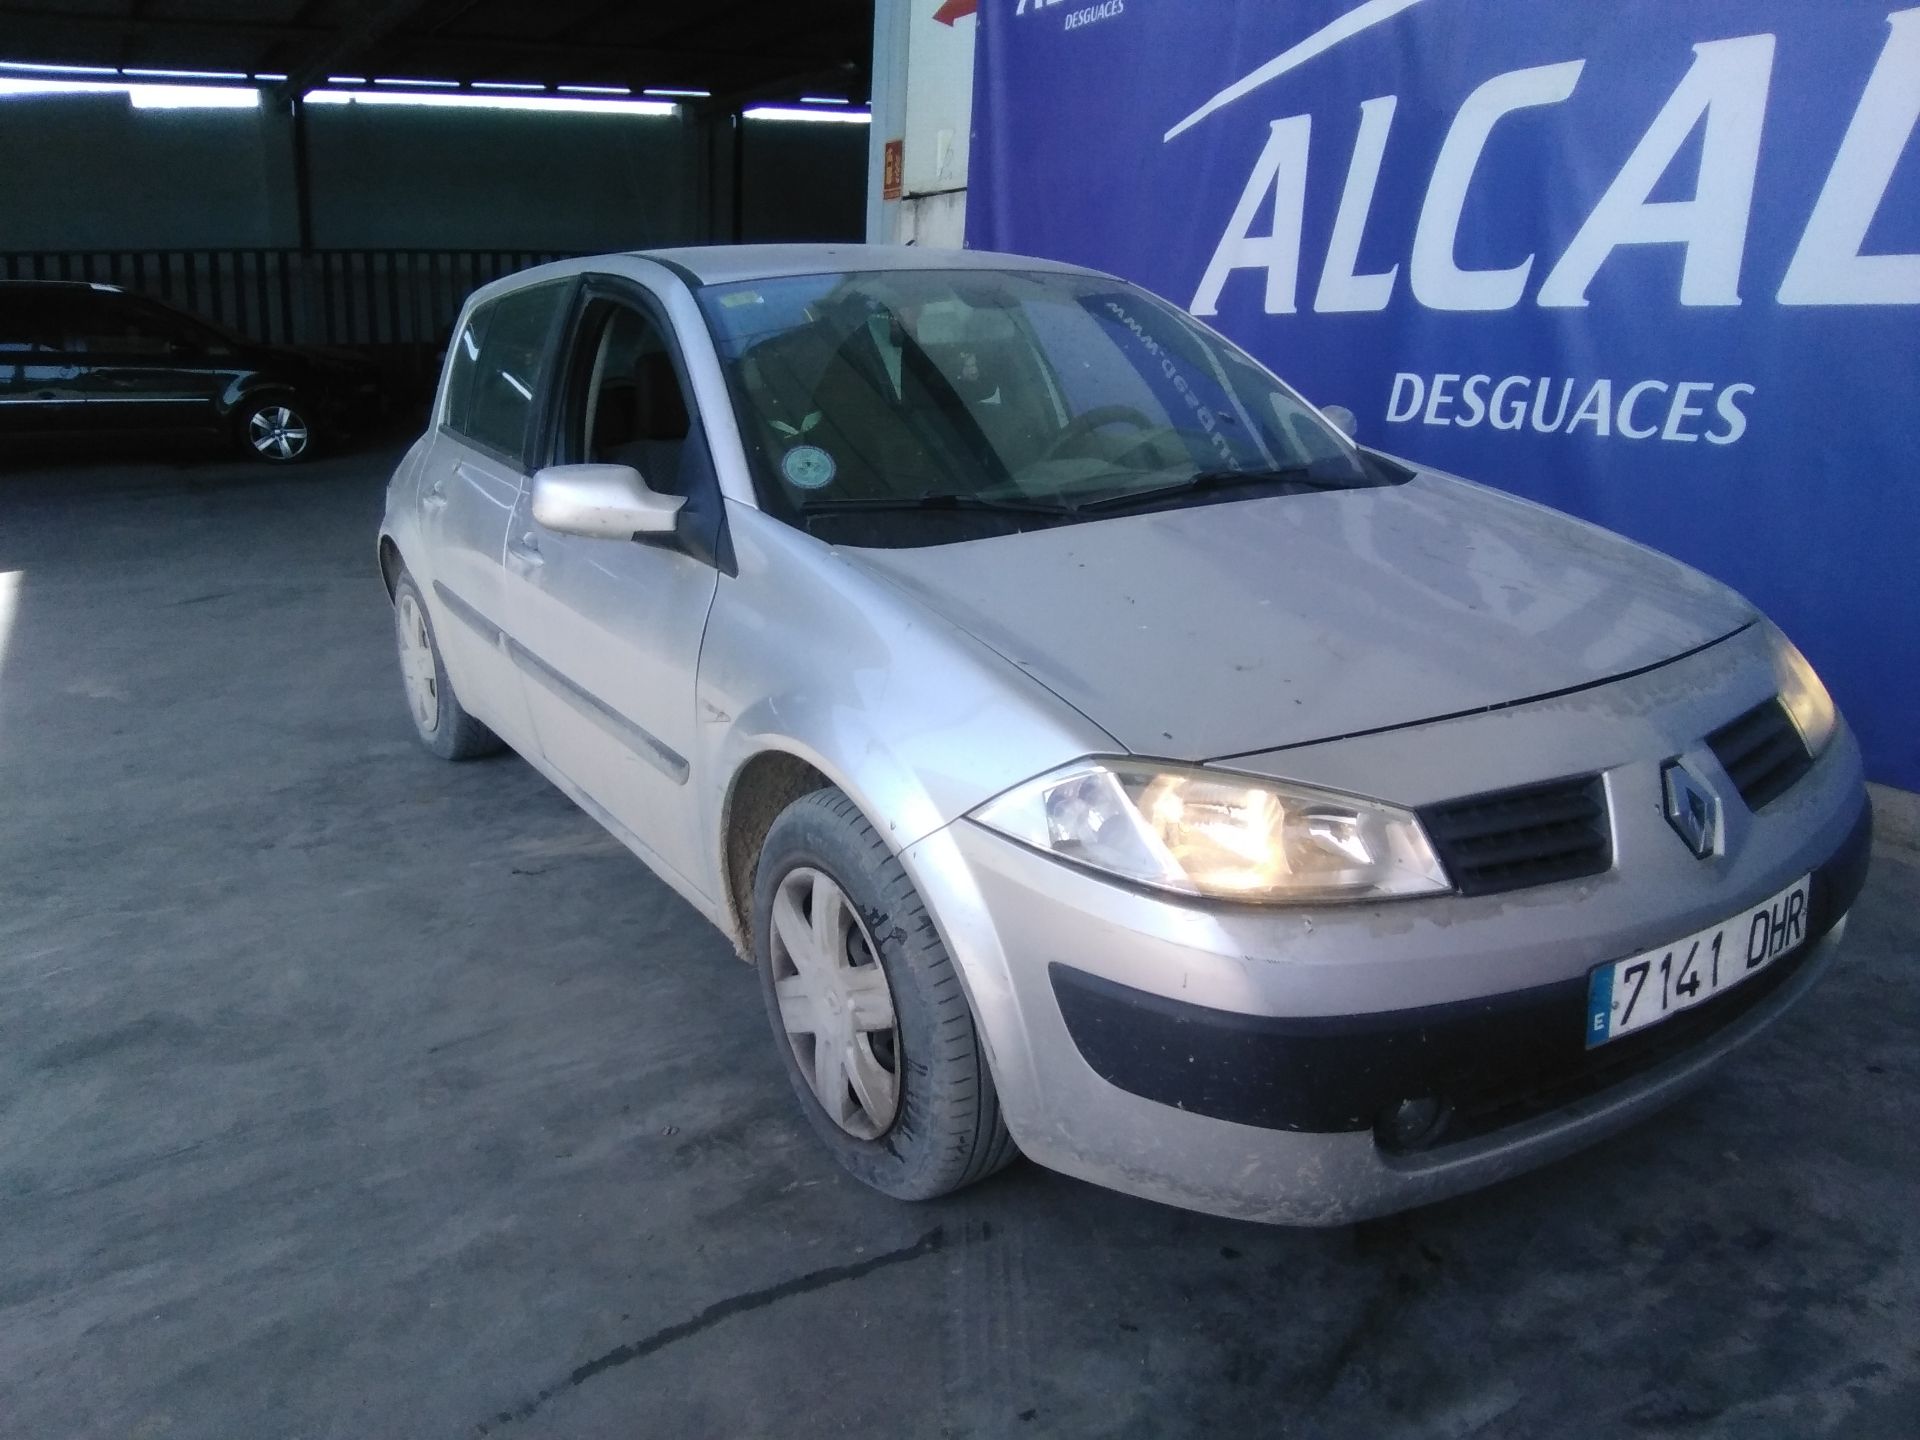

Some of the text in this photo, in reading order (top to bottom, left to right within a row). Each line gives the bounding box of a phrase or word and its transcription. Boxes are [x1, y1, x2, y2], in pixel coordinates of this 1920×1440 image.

[1064, 0, 1125, 30] DESGUACES
[1189, 6, 1920, 315] ALCAL
[1386, 372, 1756, 444] DESGUACES
[1620, 889, 1805, 1026] 7141 DHR
[1593, 1012, 1605, 1031] E
